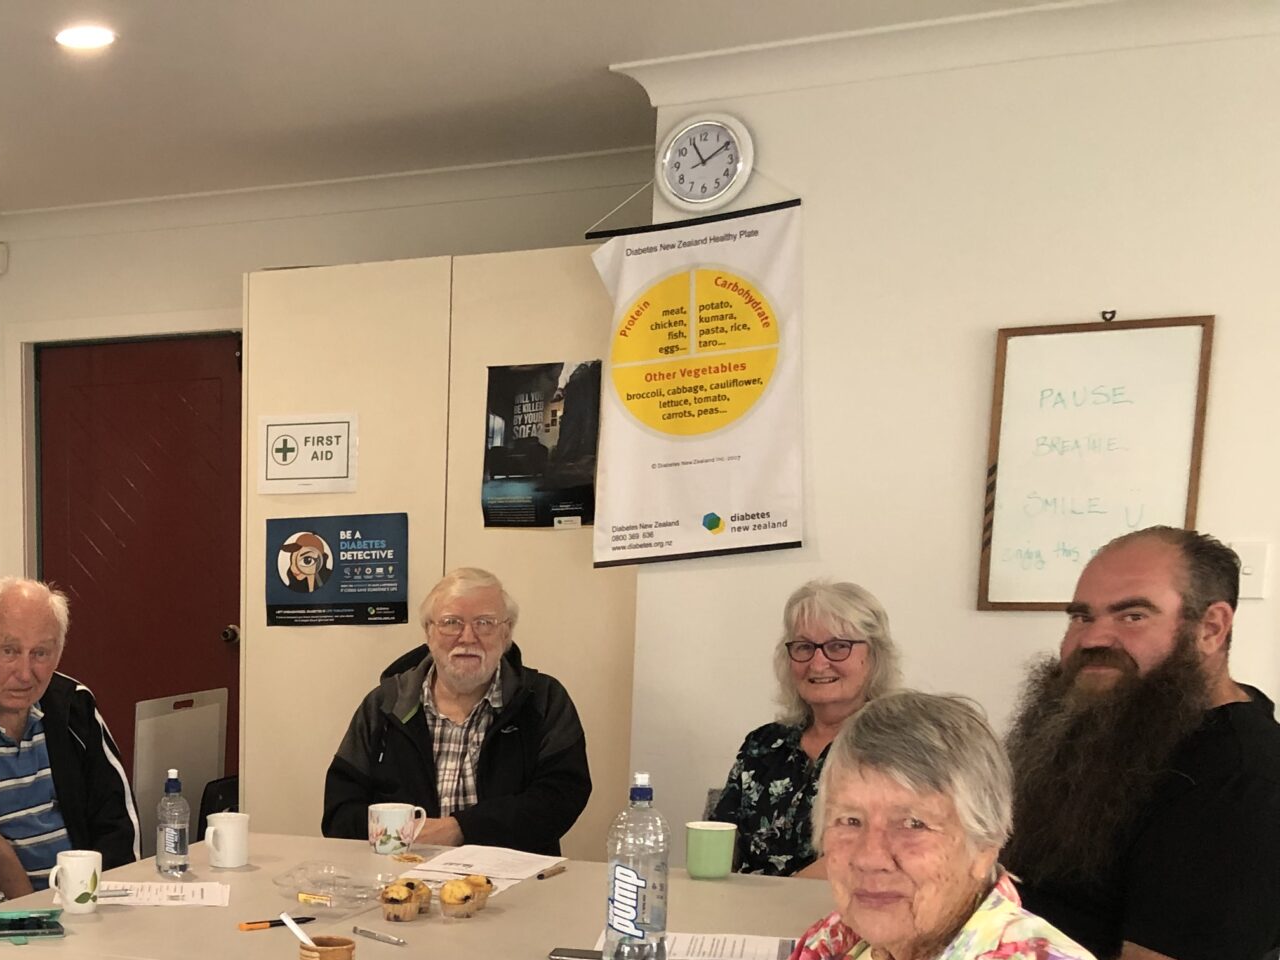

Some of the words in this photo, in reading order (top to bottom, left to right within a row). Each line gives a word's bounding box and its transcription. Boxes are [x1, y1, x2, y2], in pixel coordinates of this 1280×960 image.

[690, 137, 696, 146] 11
[700, 132, 709, 142] 12
[678, 147, 688, 157] 10
[728, 154, 733, 165] 3
[674, 162, 680, 171] 9
[723, 168, 729, 177] 4
[678, 174, 685, 185] 8
[714, 178, 720, 189] 5
[690, 182, 695, 192] 7
[701, 184, 707, 193] 6
[626, 245, 658, 257] Diabetes
[660, 242, 676, 251] New
[677, 237, 708, 249] Zealand
[709, 232, 737, 245] Healthy
[739, 229, 759, 240] Plate
[698, 300, 733, 312] potato,
[714, 276, 770, 329] Carbohydrate
[662, 306, 687, 317] meat,
[620, 300, 651, 338] Protein
[698, 312, 737, 324] kumara,
[650, 318, 687, 331] chicken,
[698, 326, 728, 338] pasta,
[730, 322, 751, 333] rice,
[668, 331, 687, 341] fish,
[644, 370, 677, 383] Other
[680, 361, 747, 379] Vegetables
[626, 387, 666, 401] broccoli,
[667, 383, 707, 397] cabbage,
[710, 376, 763, 390] cauliflower,
[659, 397, 692, 409] lettuce,
[694, 393, 730, 405] tomato,
[1039, 385, 1134, 409] PAUSE
[514, 404, 522, 415] BE
[522, 401, 544, 413] KILLED
[514, 414, 523, 425] BY
[524, 412, 544, 424] YOUR
[662, 410, 695, 420] carrots,
[512, 423, 543, 440] SOFA?
[304, 435, 342, 447] FIRST
[311, 450, 333, 461] AID
[1024, 491, 1108, 516] SMILE
[730, 511, 771, 522] diabetes
[654, 520, 680, 529] Zealand
[730, 524, 749, 533] new
[752, 520, 788, 531] zealand
[340, 530, 352, 540] BE
[354, 530, 362, 539] A
[612, 534, 627, 542] 0800
[340, 540, 386, 550] DIABETES
[612, 540, 673, 551] www.diabetes.org.nz
[340, 550, 394, 561] DETECTIVE
[166, 828, 177, 854] pump
[612, 864, 646, 939] pump
